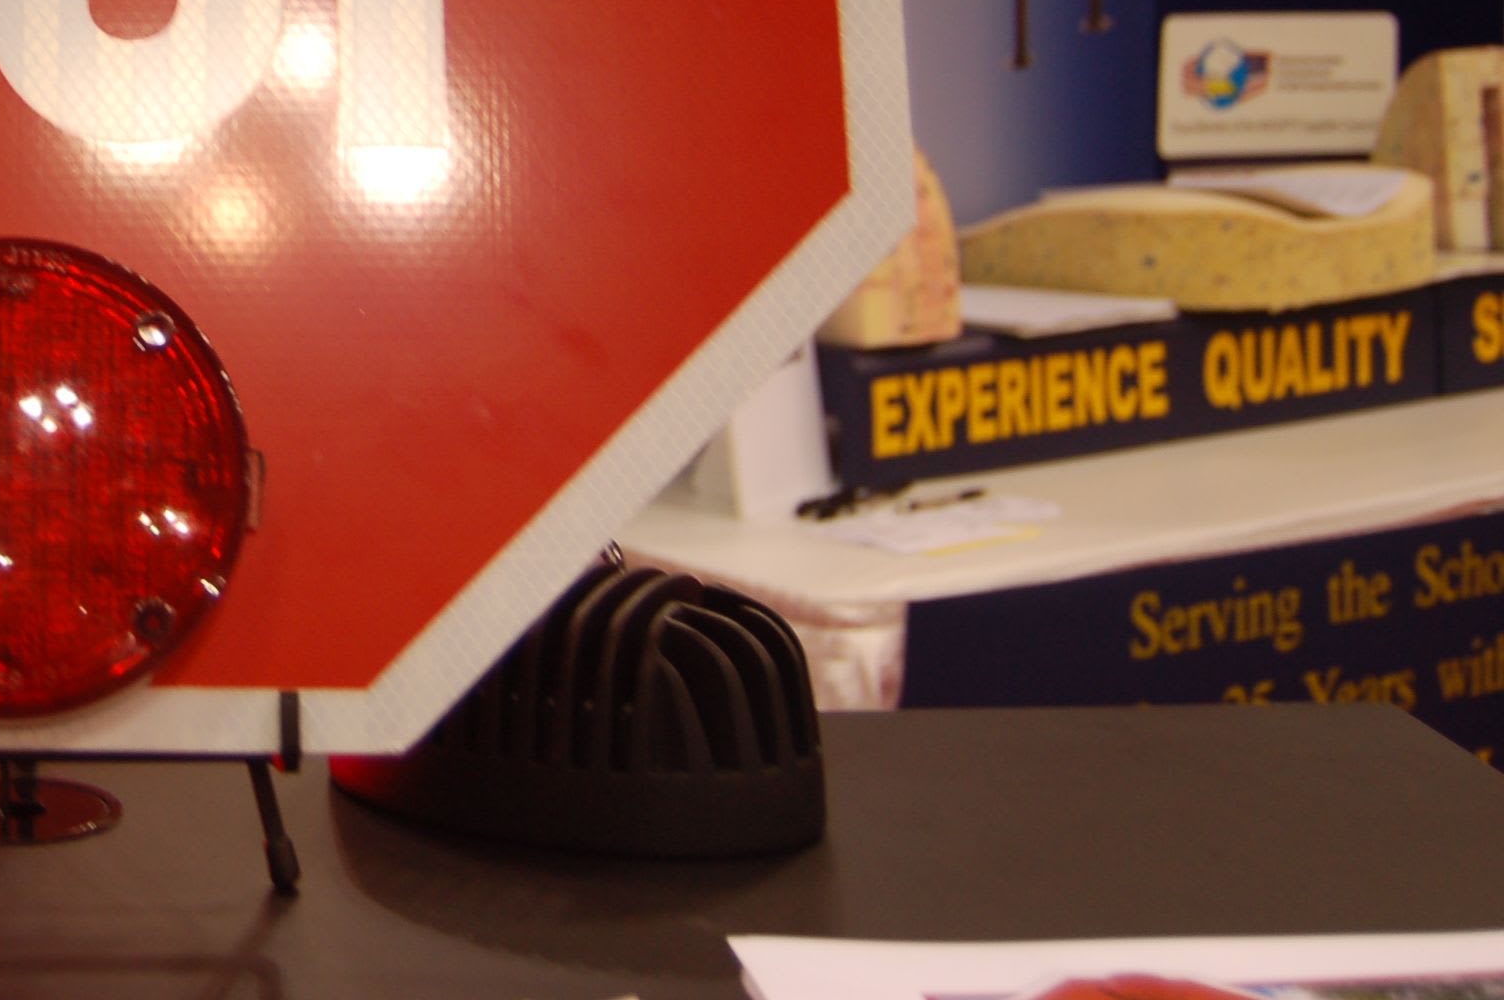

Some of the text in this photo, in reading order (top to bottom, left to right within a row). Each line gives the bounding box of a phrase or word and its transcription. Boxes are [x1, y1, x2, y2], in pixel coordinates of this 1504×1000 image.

[870, 340, 1170, 459] EXPERIENCE
[1202, 311, 1412, 411] QUALITY
[1129, 576, 1303, 661] Serving
[1326, 560, 1393, 625] the
[1303, 665, 1417, 711] Years
